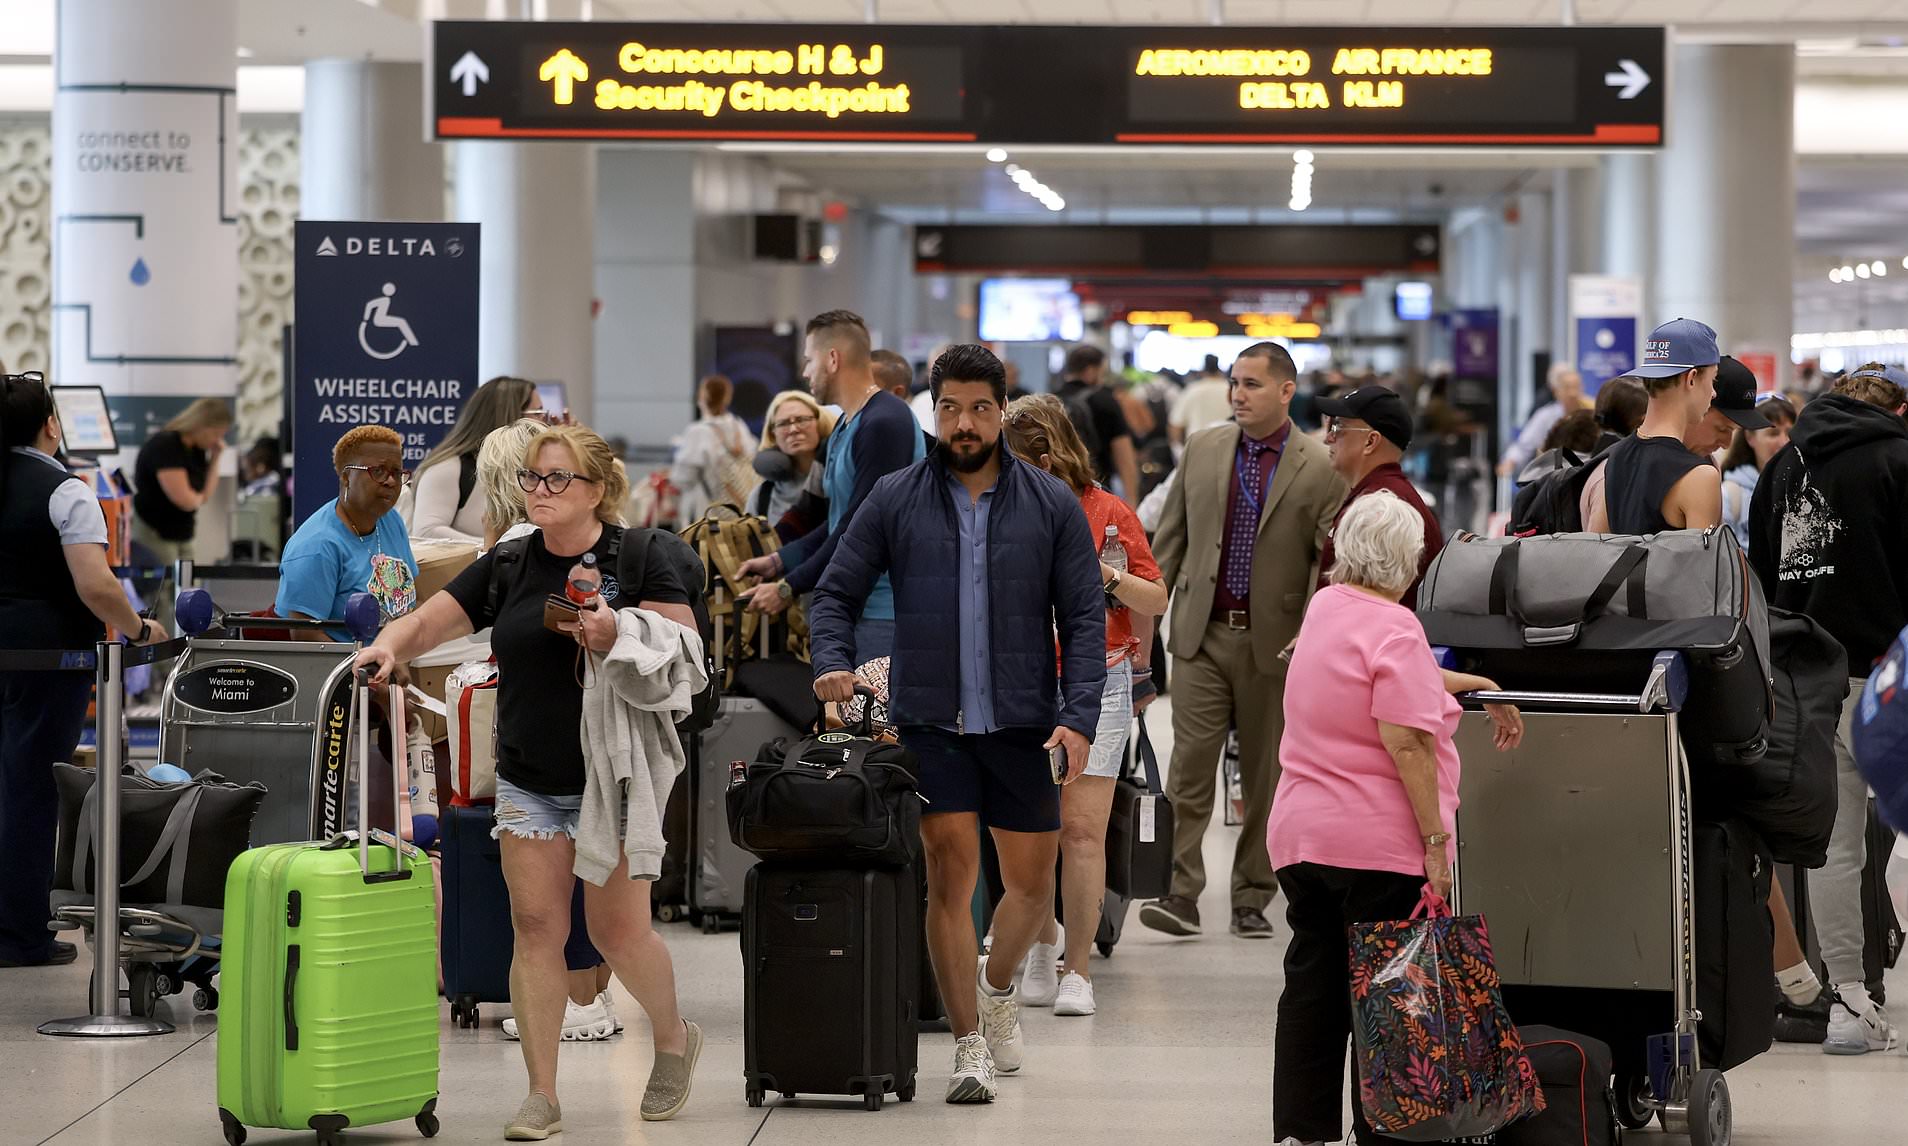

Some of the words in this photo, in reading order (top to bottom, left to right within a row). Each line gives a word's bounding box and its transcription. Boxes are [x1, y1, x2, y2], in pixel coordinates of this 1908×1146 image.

[619, 42, 793, 74] Concourse
[798, 44, 825, 75] H
[829, 44, 857, 75] &
[859, 44, 883, 75] J
[1136, 50, 1310, 76] AEROMEXICO
[1332, 48, 1380, 75] AIR
[1381, 48, 1493, 75] FRANCE
[594, 79, 725, 117] Security
[729, 81, 910, 118] Checkpoint
[1240, 82, 1330, 108] DELTA
[1344, 81, 1404, 108] KLM
[77, 131, 160, 150] connect
[168, 130, 191, 150] to
[346, 237, 436, 256] DELTA
[1659, 341, 1670, 349] OF
[314, 378, 461, 399] WHEELCHAIR
[318, 404, 456, 425] ASSISTANCE
[407, 433, 426, 446] DE
[401, 447, 432, 461] UED
[1778, 568, 1802, 581] WAY
[209, 677, 244, 686] Welcome
[246, 678, 255, 686] to
[211, 688, 250, 701] Miami
[323, 702, 345, 841] martecarte
